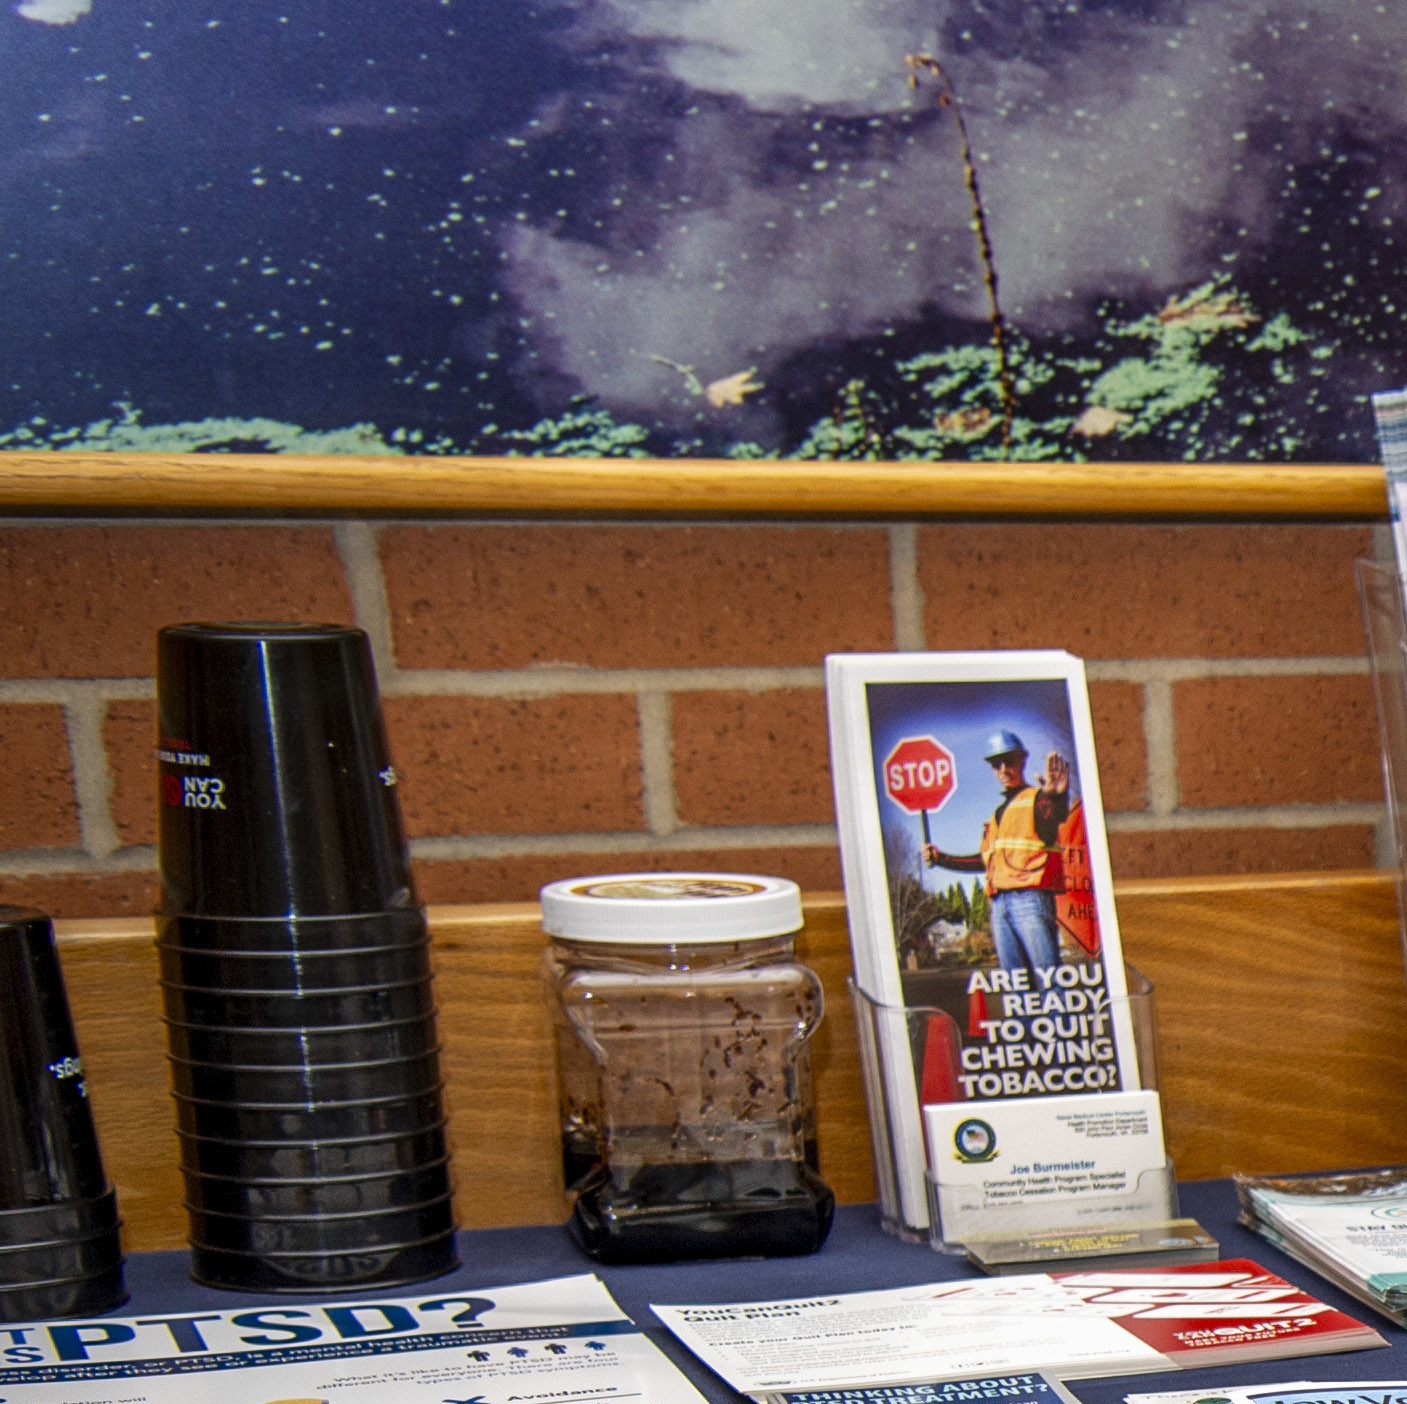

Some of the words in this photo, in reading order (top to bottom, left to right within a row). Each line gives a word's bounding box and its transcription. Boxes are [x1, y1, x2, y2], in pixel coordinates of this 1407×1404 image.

[185, 777, 226, 793] CAN
[889, 759, 950, 791] STOP
[185, 793, 227, 809] YOU
[966, 967, 1031, 994] ARE
[1035, 962, 1104, 990] YOU
[1002, 987, 1106, 1018] READY
[979, 1019, 1026, 1044] TO
[1030, 1012, 1110, 1045] QUIT
[961, 1038, 1115, 1071] CHEWING
[957, 1064, 1117, 1098] TOBACCO?
[1010, 1164, 1030, 1175] Joe
[1033, 1159, 1096, 1173] Burmeister
[983, 1178, 1027, 1191] Community
[1029, 1176, 1052, 1187] Health
[1054, 1174, 1088, 1187] Program
[1089, 1171, 1126, 1183] Specialist
[984, 1188, 1017, 1199] Tobacco
[1018, 1186, 1056, 1197] Cessation
[1058, 1184, 1092, 1197] Program
[1093, 1181, 1127, 1194] Manager
[675, 1299, 842, 1316] YouCanQuit2
[682, 1313, 745, 1323] Quit
[752, 1310, 802, 1321] Plan
[47, 1297, 496, 1362] PTSD?
[39, 1363, 136, 1375] disorder,
[174, 1355, 241, 1367] PTSD,
[289, 1341, 362, 1358] mental
[369, 1335, 434, 1348] health
[440, 1330, 520, 1342] concern
[526, 1325, 570, 1334] that
[506, 1386, 618, 1402] Avoidance
[793, 1385, 929, 1402] THINKING
[936, 1375, 1035, 1393] ABOUT
